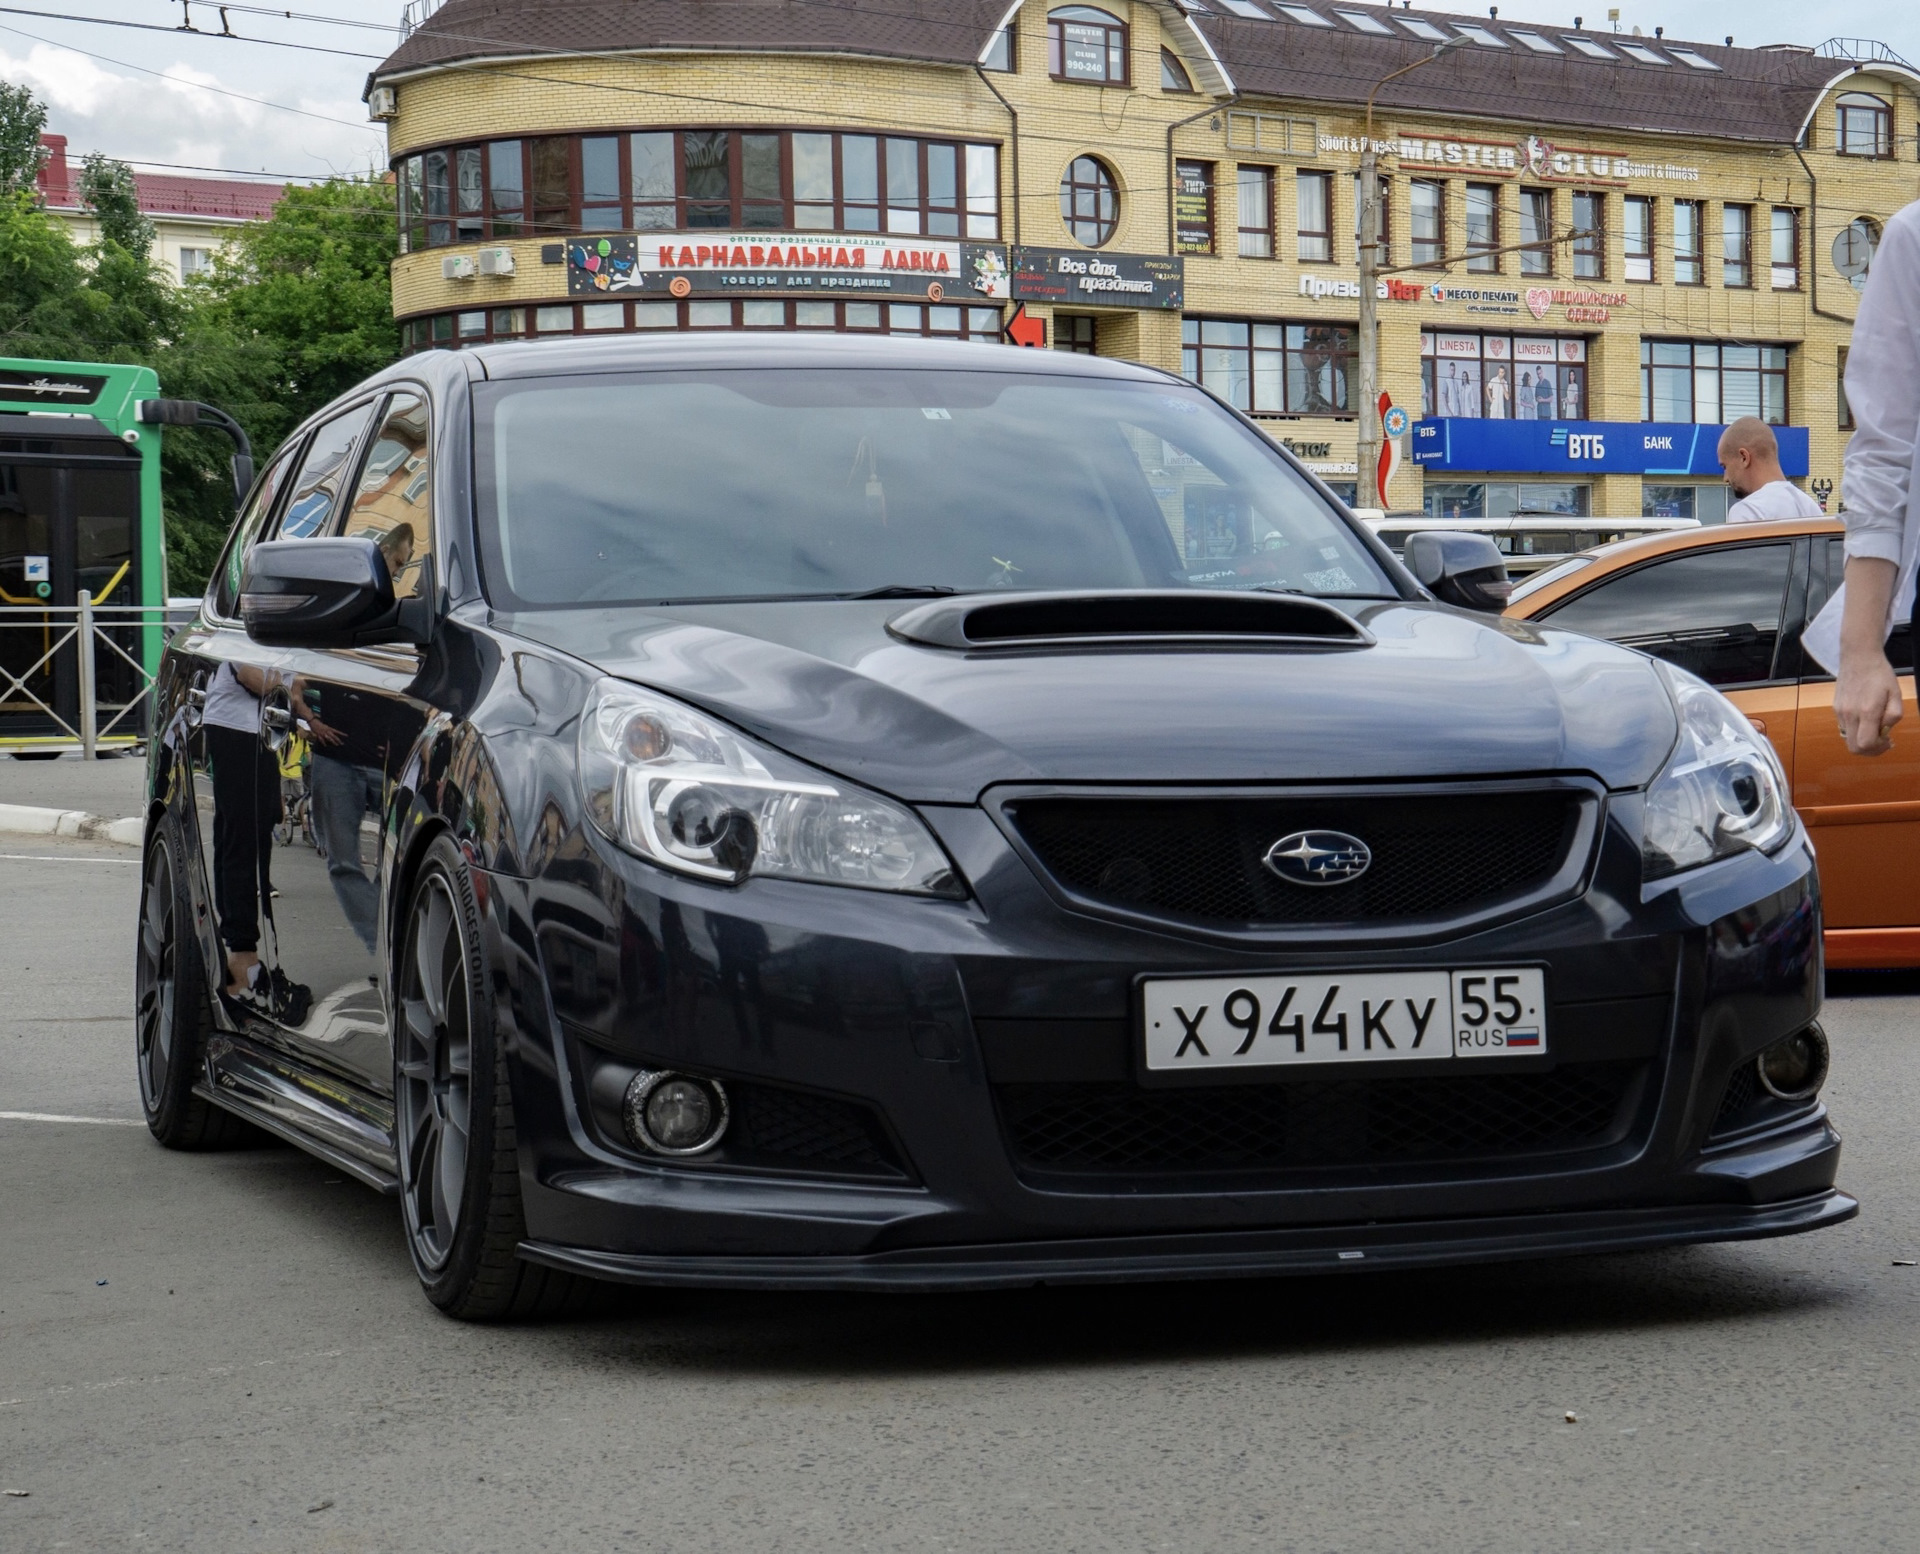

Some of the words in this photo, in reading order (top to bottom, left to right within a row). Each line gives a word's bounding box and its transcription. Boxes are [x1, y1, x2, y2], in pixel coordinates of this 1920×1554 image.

[1066, 26, 1103, 37] MASTER
[1075, 50, 1097, 59] CLUB
[1066, 60, 1103, 73] 990-240
[1318, 135, 1349, 152] sport
[1350, 138, 1359, 152] &
[1399, 139, 1515, 168] MASTER
[1554, 153, 1630, 178] CLUB
[1629, 163, 1656, 178] sport
[1656, 165, 1664, 179] &
[1665, 163, 1699, 181] fitness
[845, 238, 886, 246] магазин
[658, 245, 866, 270] КАРНАВАЛЬНАЯ
[881, 248, 951, 273] ЛАВКА
[1058, 257, 1086, 274] Все
[1089, 259, 1118, 277] для
[721, 276, 778, 286] товары
[787, 276, 812, 286] для
[820, 277, 892, 288] праздника
[1079, 275, 1154, 293] праздника
[1446, 289, 1479, 301] МЕСТО
[1482, 290, 1519, 303] ПЕЧАТИ
[1551, 290, 1627, 306] МЕДИЦИНСКАЯ
[1566, 307, 1612, 324] ОДЕЖДА
[1440, 340, 1476, 352] LINESTA
[1517, 343, 1552, 356] LINESTA
[1420, 426, 1436, 438] ВТБ
[1568, 434, 1606, 459] ВТБ
[1644, 436, 1673, 450] БАНК
[1166, 457, 1194, 465] LINESTA
[1461, 976, 1522, 1026] 55
[1458, 1028, 1505, 1047] RUS
